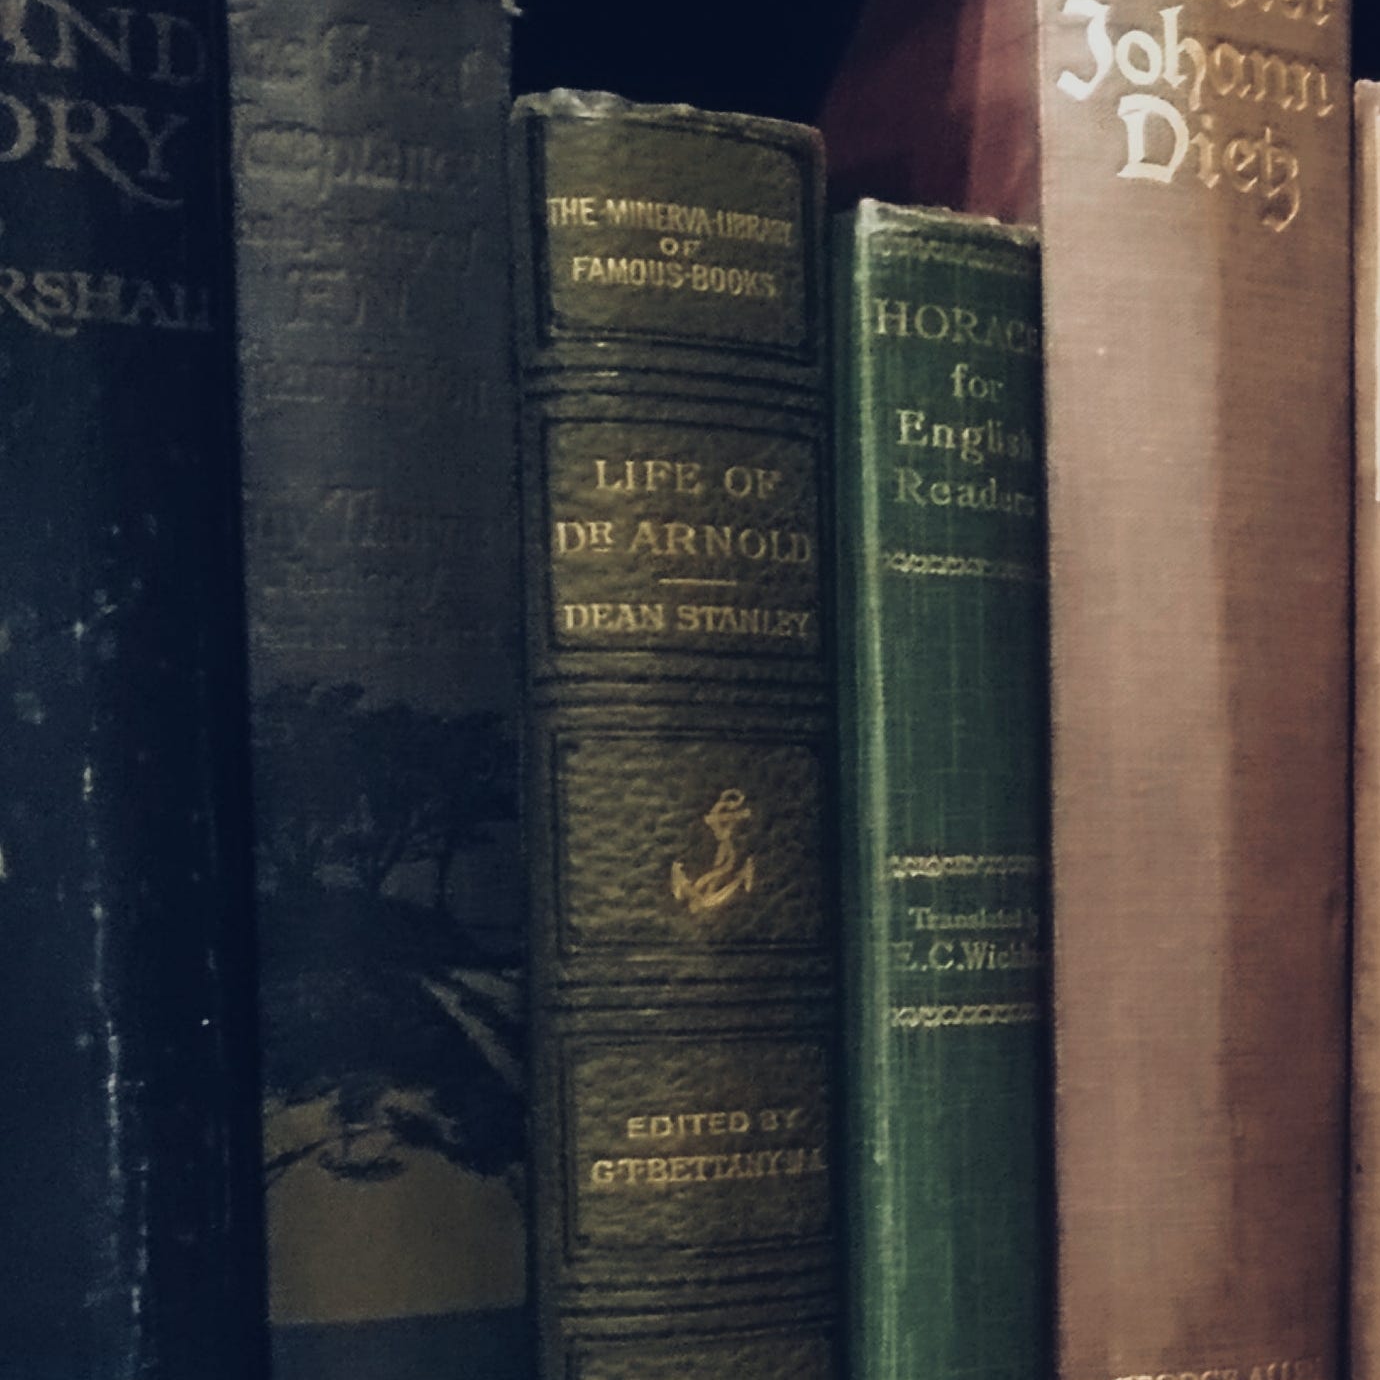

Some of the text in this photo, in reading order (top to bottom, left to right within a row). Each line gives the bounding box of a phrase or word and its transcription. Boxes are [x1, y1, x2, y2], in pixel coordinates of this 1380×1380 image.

[659, 237, 701, 258] OF
[950, 363, 1005, 403] for
[897, 408, 1035, 465] English
[595, 459, 783, 498] LIFE OF
[628, 522, 813, 564] ARNOLD
[563, 604, 810, 639] DEAN STANLEY
[627, 1111, 750, 1139] EDITED
